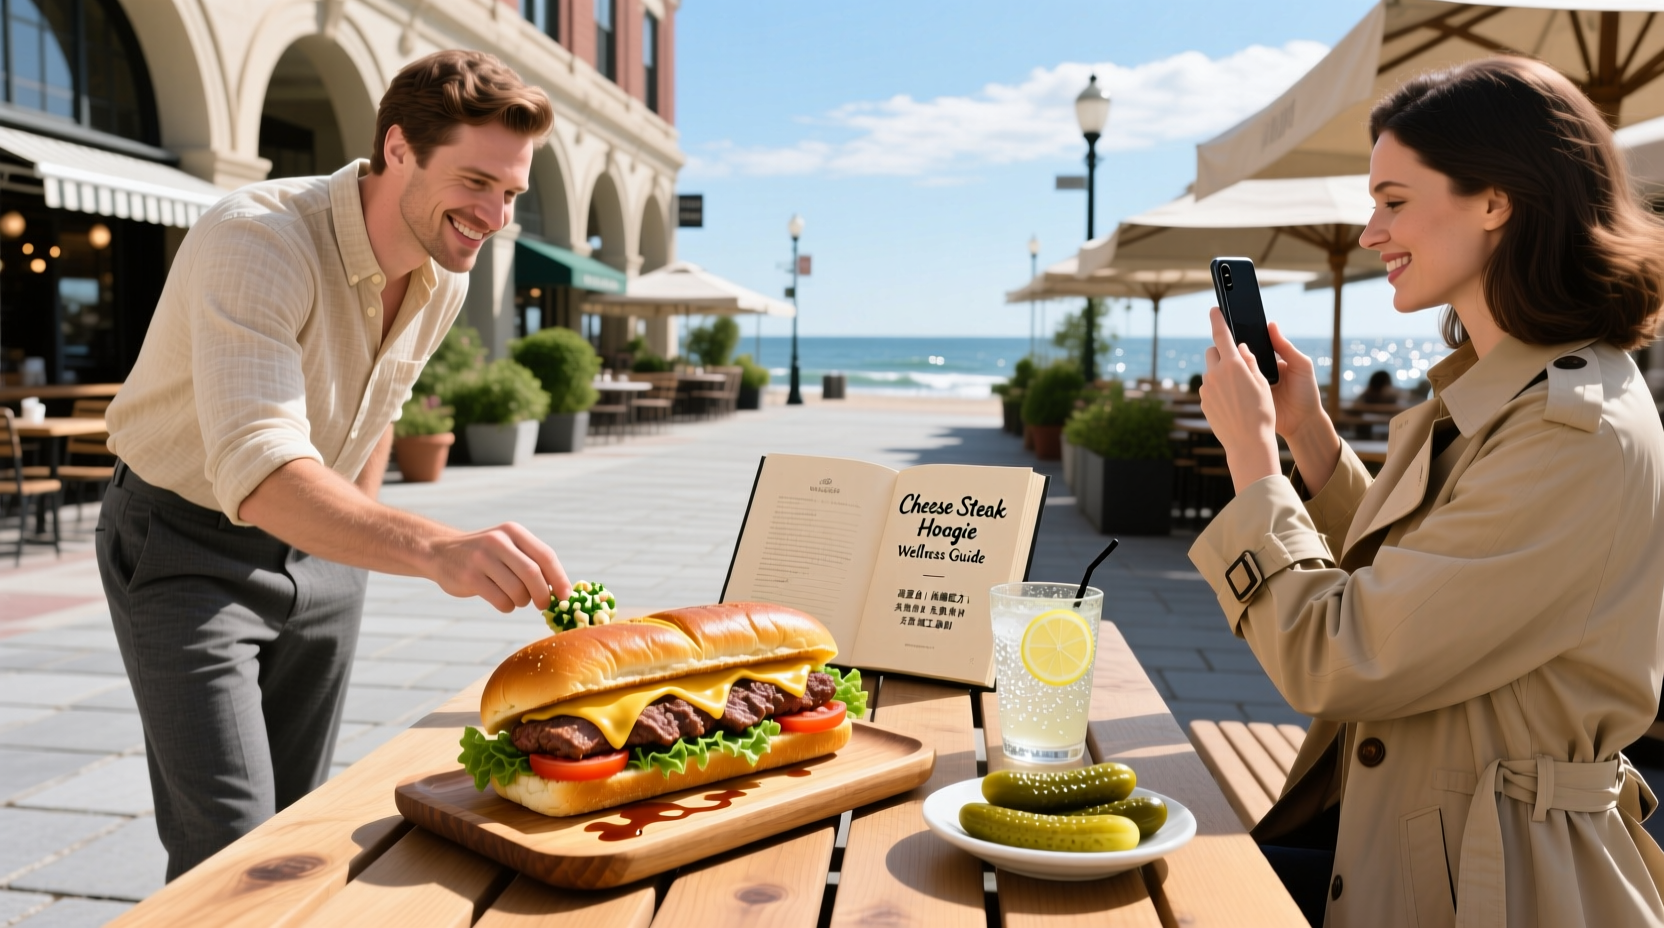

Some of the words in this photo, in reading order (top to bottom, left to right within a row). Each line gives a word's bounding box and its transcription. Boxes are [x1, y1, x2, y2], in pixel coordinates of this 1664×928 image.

[899, 493, 954, 515] Cheese
[956, 496, 1007, 519] Steak
[917, 517, 978, 546] Hoagie
[949, 548, 986, 564] Guide
